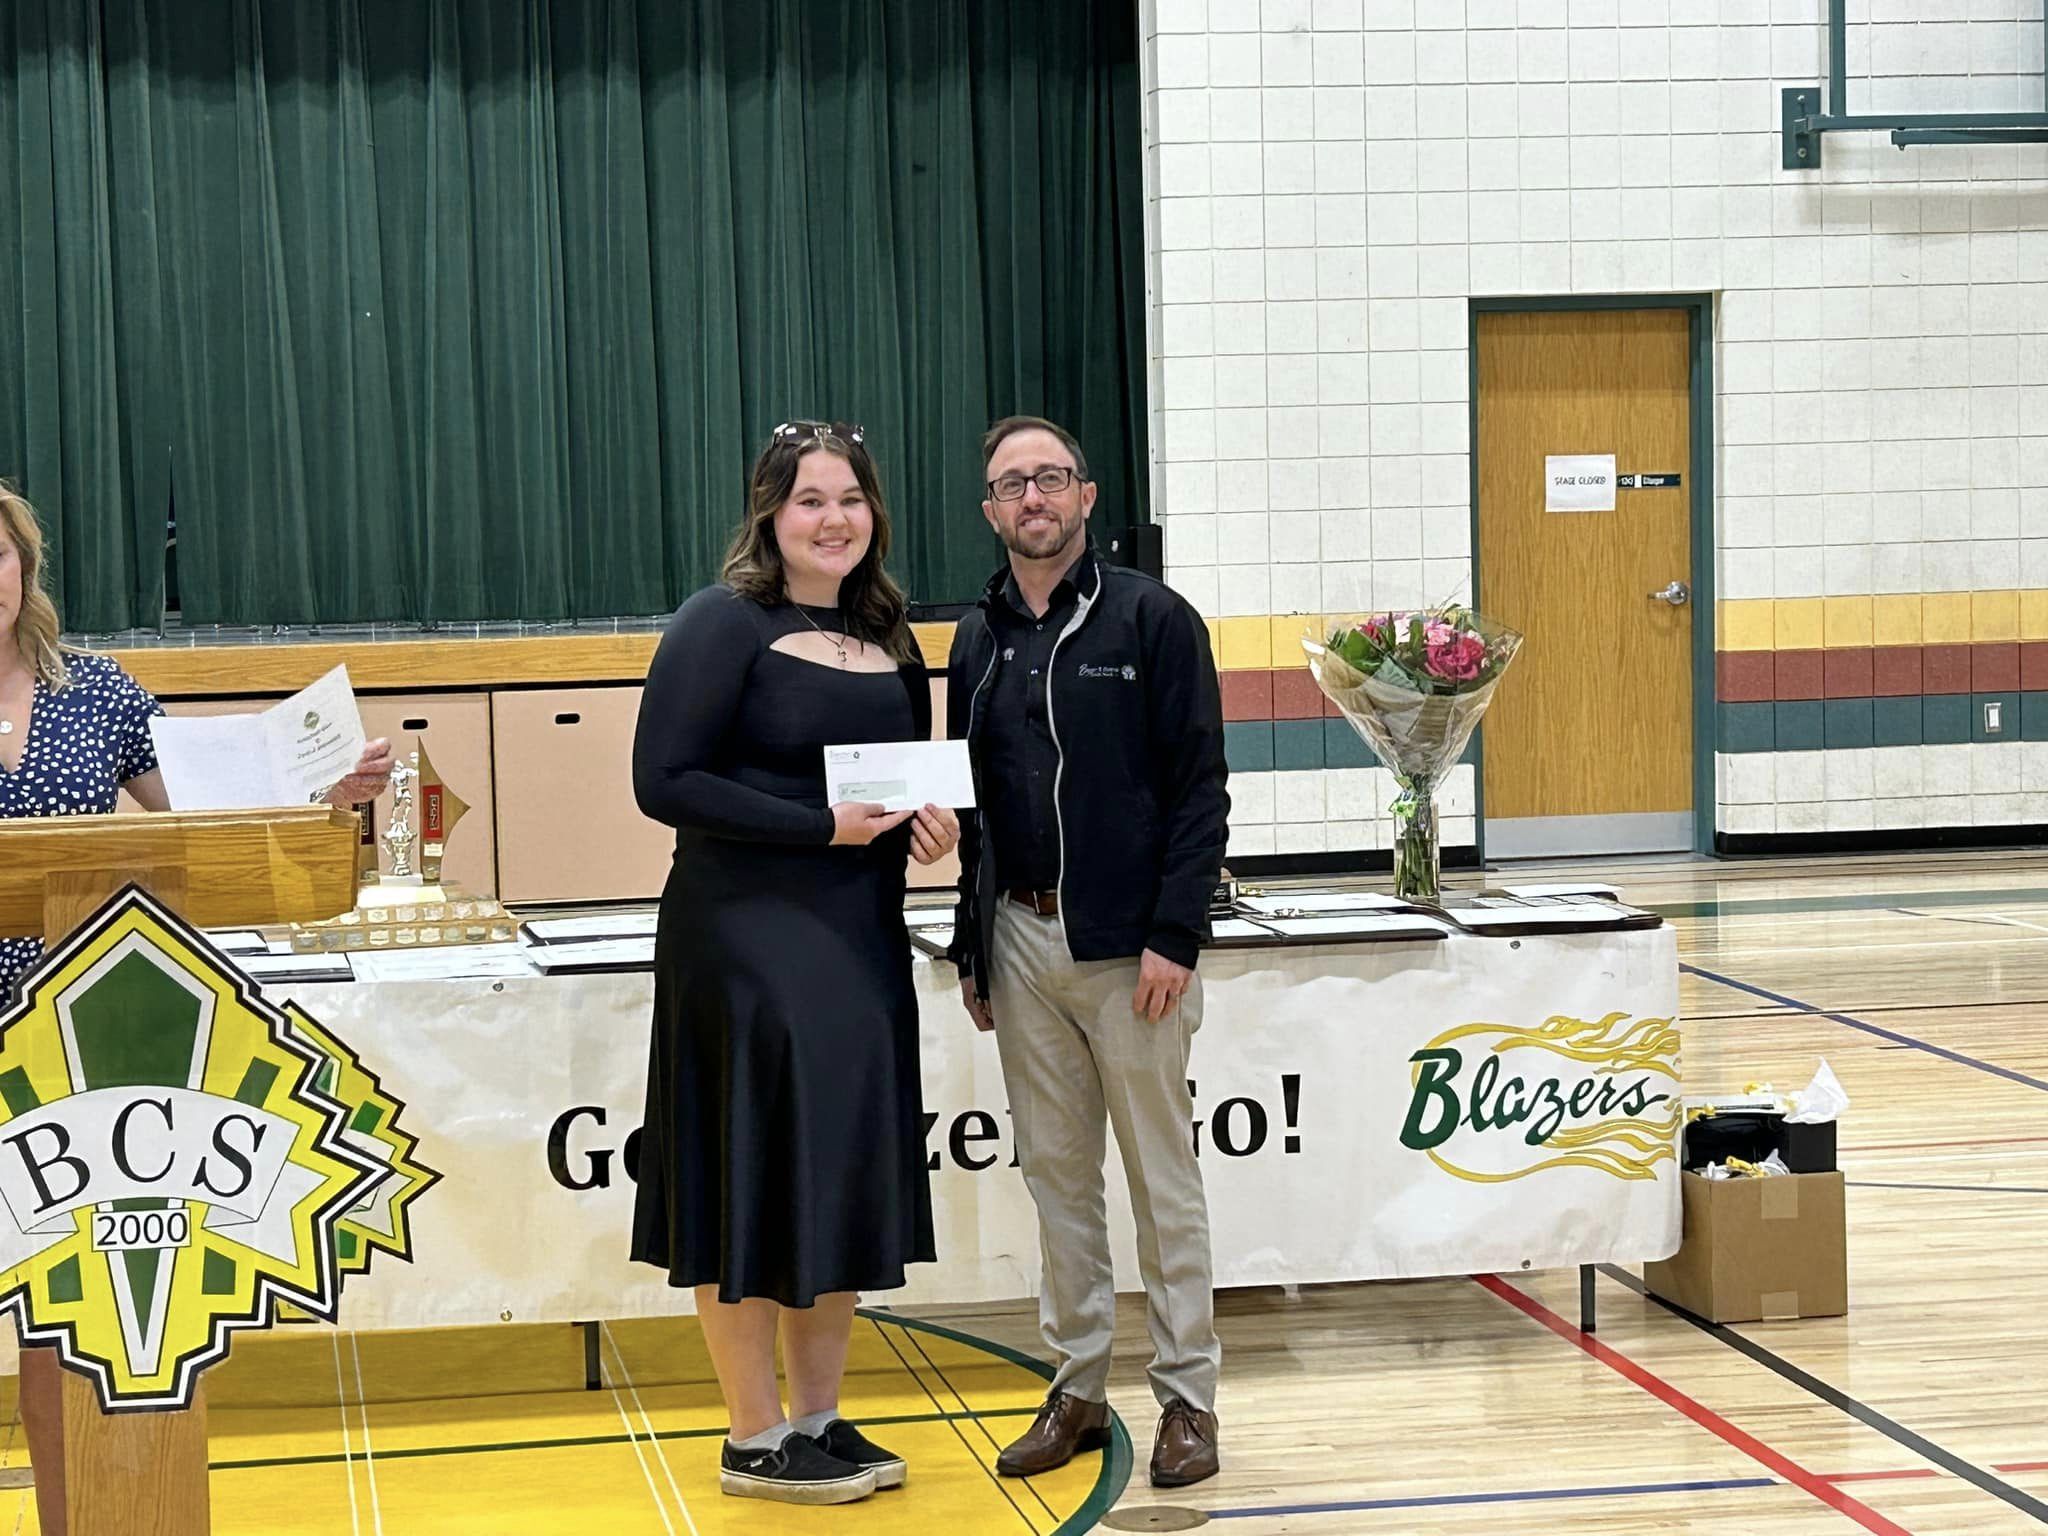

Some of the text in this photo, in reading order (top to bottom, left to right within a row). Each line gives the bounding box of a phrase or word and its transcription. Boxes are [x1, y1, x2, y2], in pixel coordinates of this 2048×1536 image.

[1578, 476, 1606, 485] CLOSED
[1186, 1073, 1301, 1157] o!
[1399, 1047, 1670, 1150] Blazers
[1, 1097, 267, 1215] BCS
[96, 1212, 188, 1246] 2000
